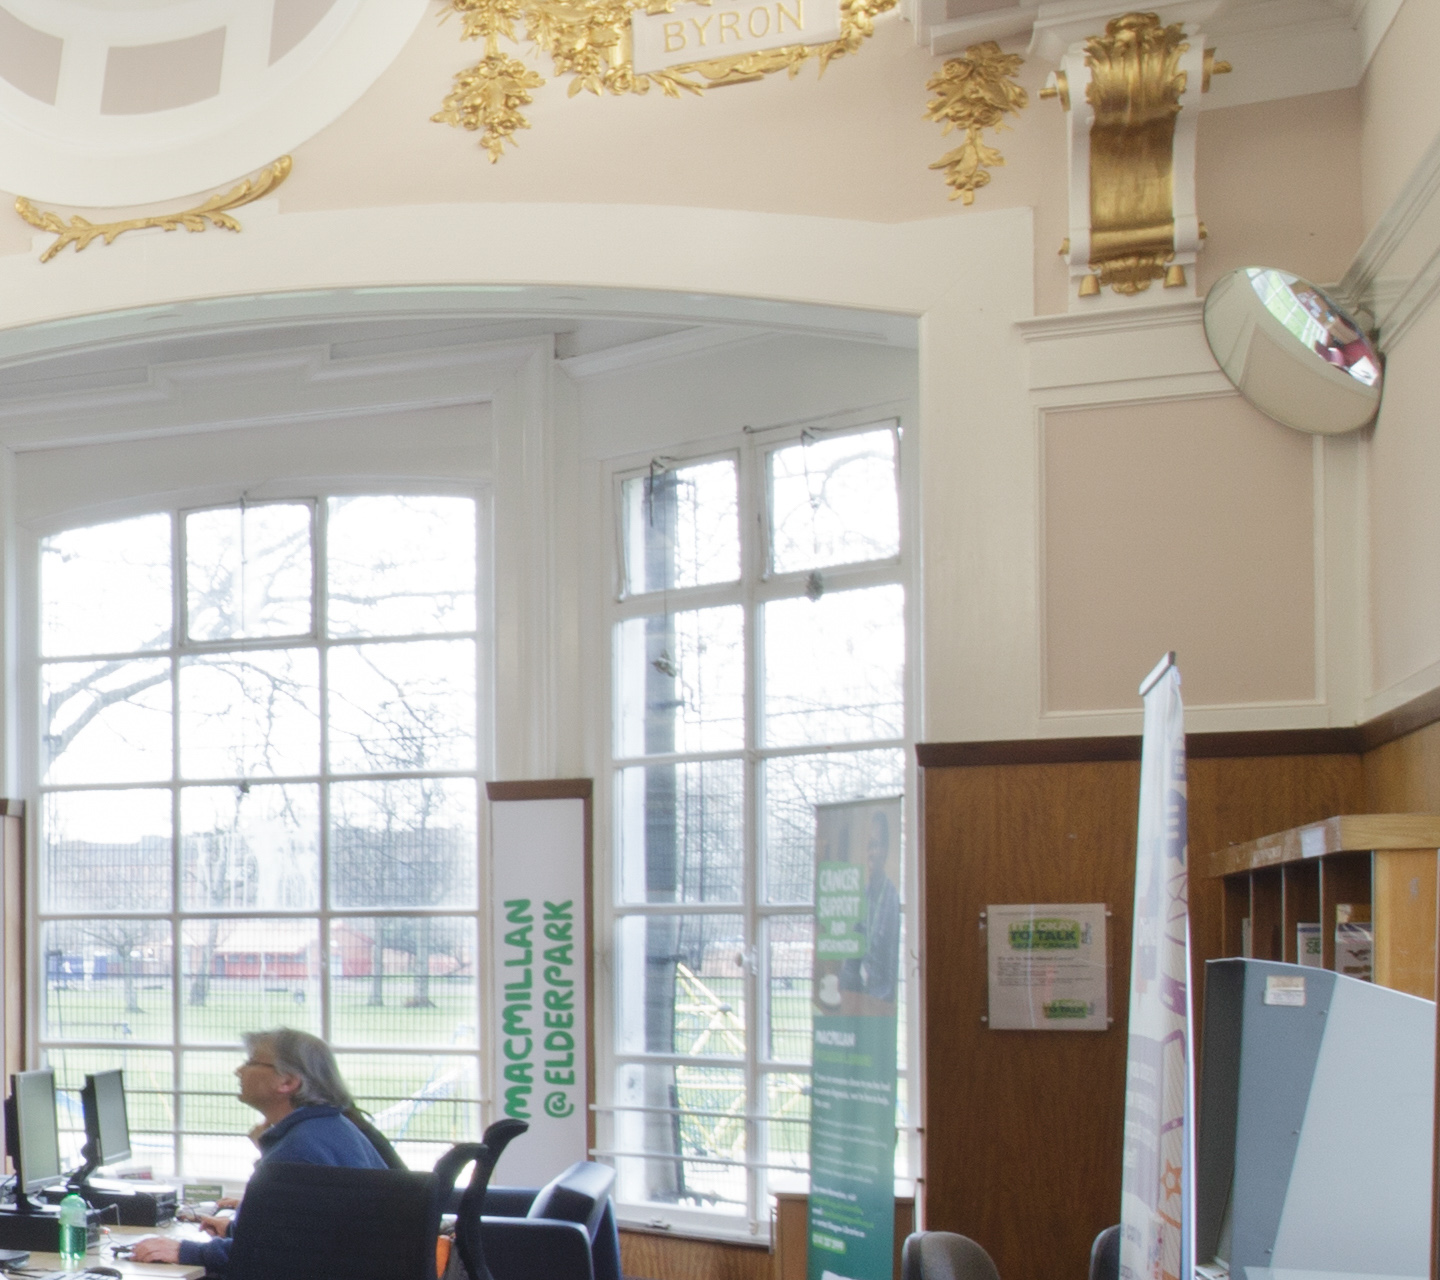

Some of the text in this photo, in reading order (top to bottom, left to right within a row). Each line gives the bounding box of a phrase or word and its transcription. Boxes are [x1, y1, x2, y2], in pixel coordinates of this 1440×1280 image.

[662, 0, 806, 53] BYRON
[820, 868, 861, 892] CANCER
[819, 896, 860, 918] SUPPORT
[502, 899, 534, 1119] MACMILLAN
[543, 900, 575, 1118] @ELDERPARK
